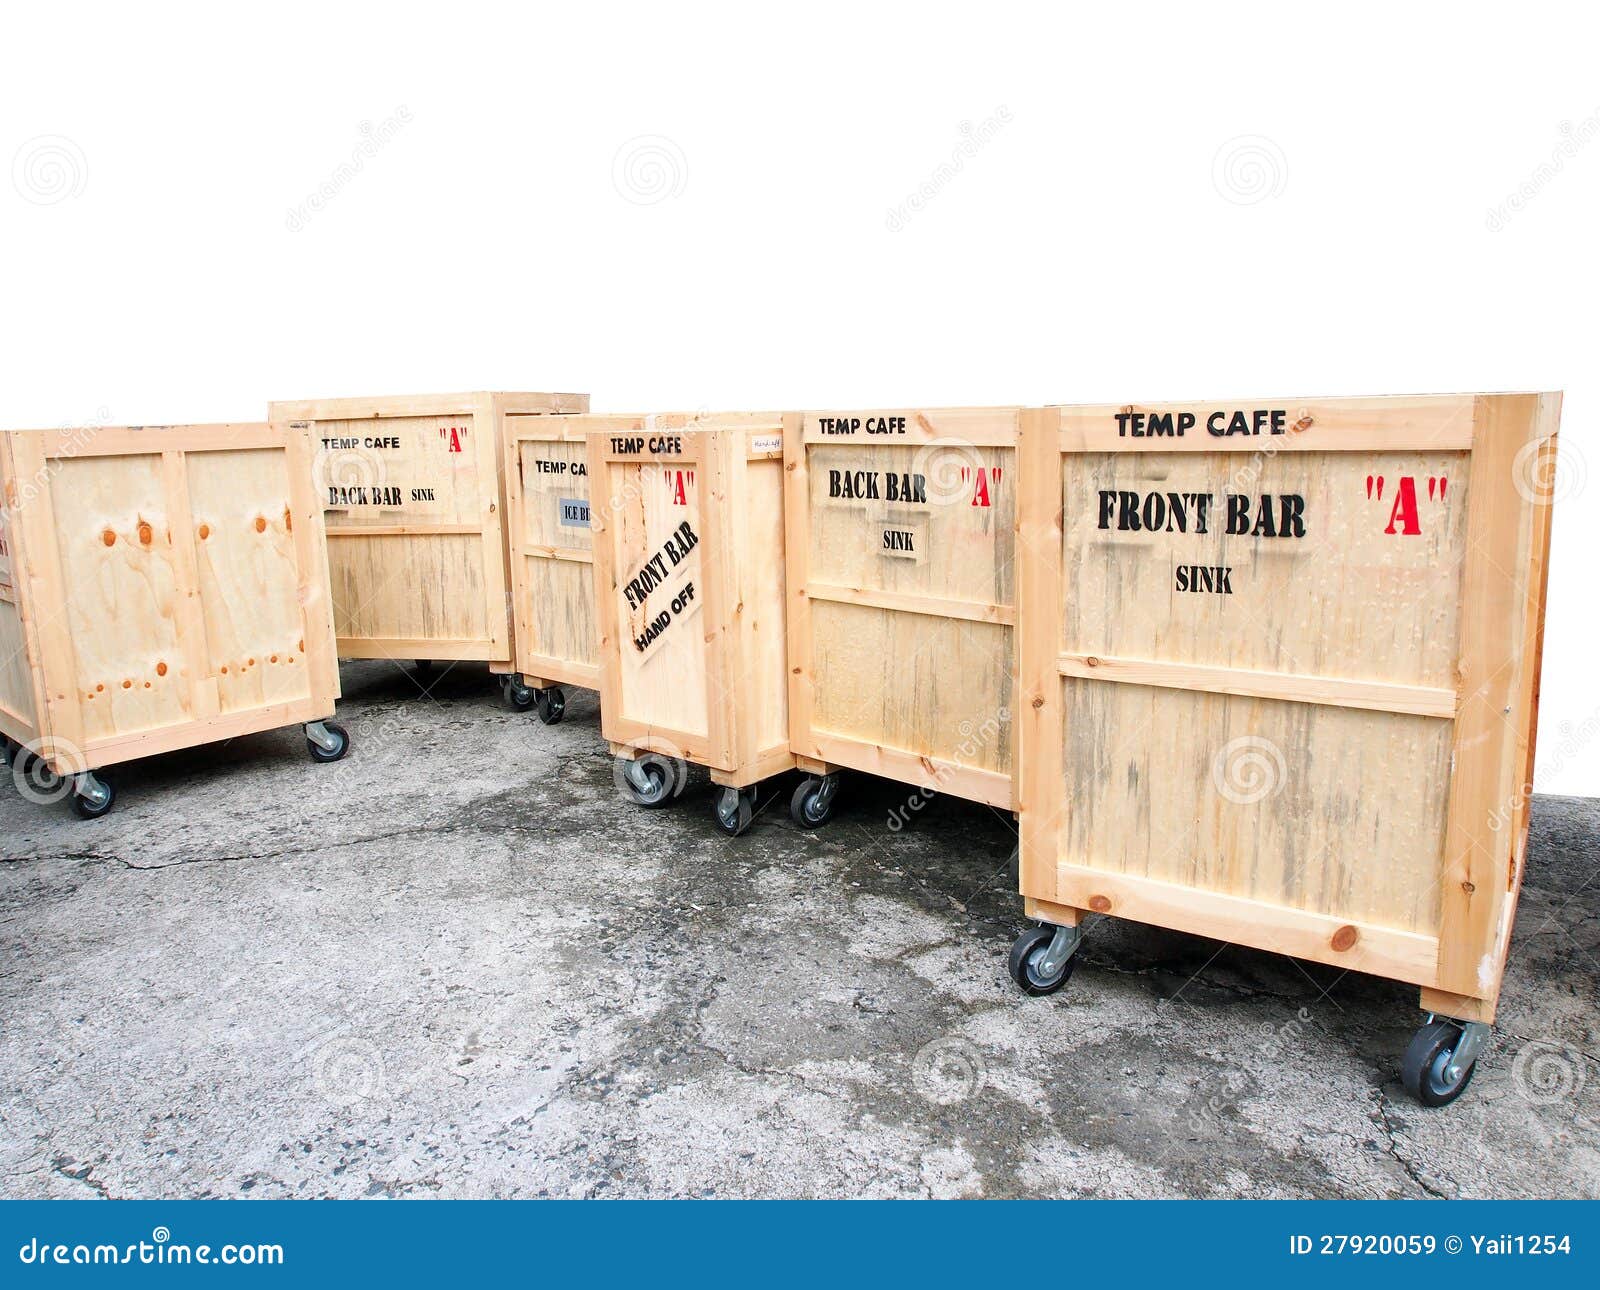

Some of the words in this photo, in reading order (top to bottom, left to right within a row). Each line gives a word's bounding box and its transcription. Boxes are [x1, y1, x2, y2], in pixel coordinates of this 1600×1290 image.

[818, 418, 861, 435] TEMP
[865, 417, 906, 435] CAFE
[1115, 413, 1196, 437] TEMP
[1206, 410, 1286, 437] CAFE
[322, 438, 359, 449] TEMP
[364, 437, 400, 449] CAFE
[610, 437, 645, 454] TEMP
[648, 436, 682, 454] CAFE
[535, 460, 567, 474] TEMP
[570, 462, 588, 476] CA
[328, 487, 369, 505] BACK
[372, 487, 402, 506] BAR
[411, 488, 435, 501] SINK
[829, 470, 881, 500] BACK
[886, 472, 927, 504] BAR
[564, 505, 577, 520] ICE
[1098, 490, 1214, 534] FRONT
[1225, 493, 1307, 538] BAR
[883, 530, 914, 552] SINK
[623, 551, 670, 611] FRONT
[663, 520, 699, 567] BAR
[1175, 565, 1233, 595] SINK
[635, 610, 671, 653] HAND
[671, 582, 695, 615] OFF
